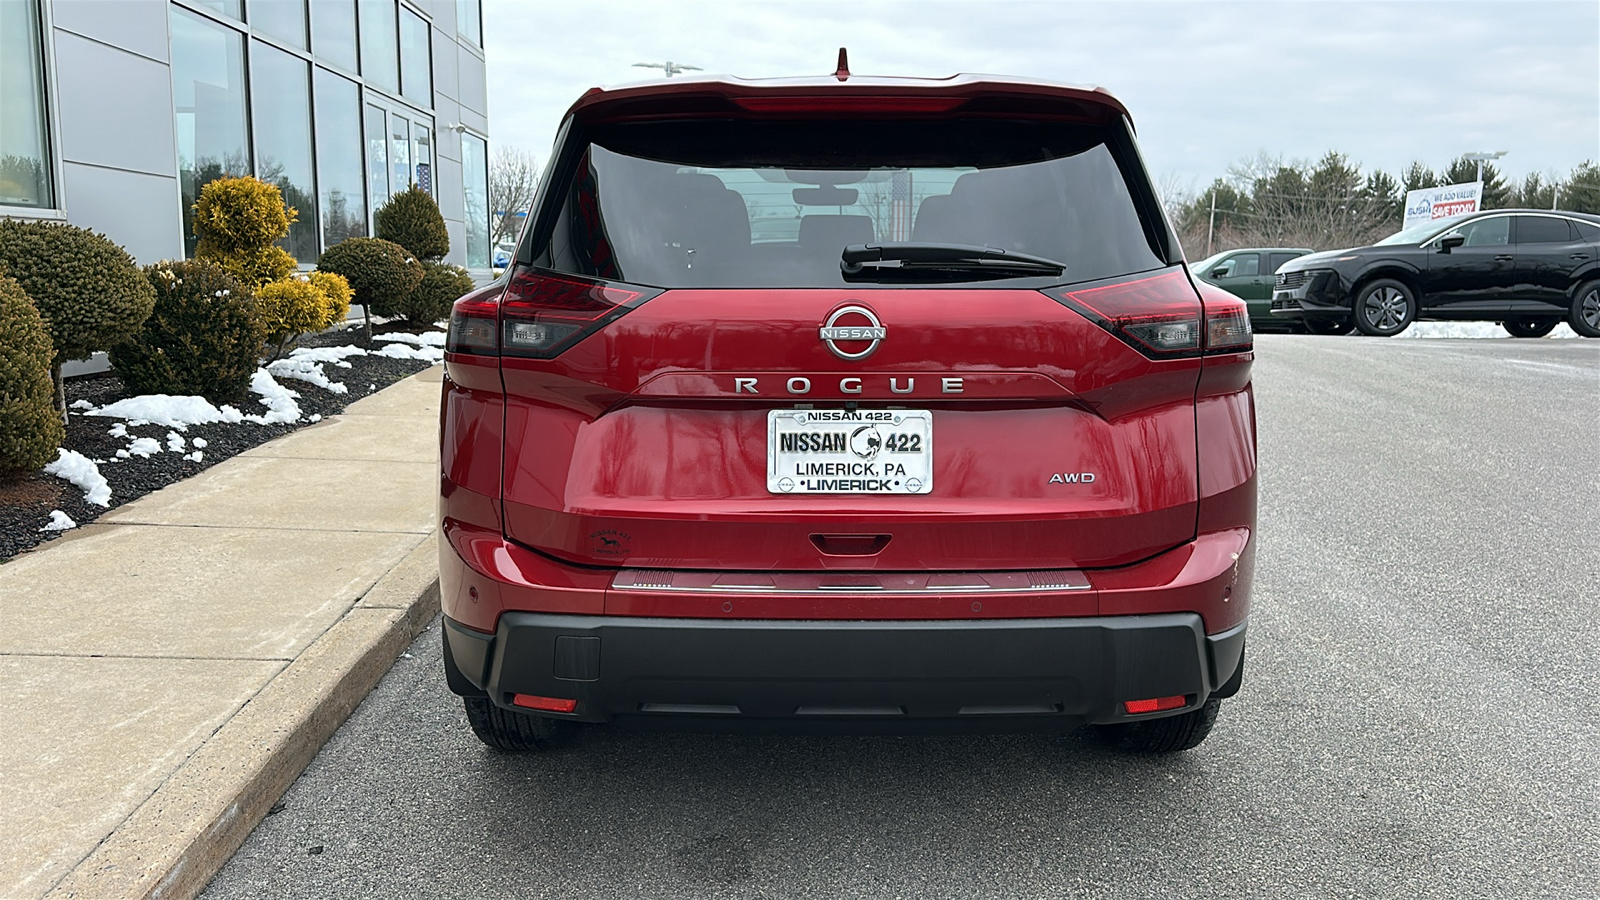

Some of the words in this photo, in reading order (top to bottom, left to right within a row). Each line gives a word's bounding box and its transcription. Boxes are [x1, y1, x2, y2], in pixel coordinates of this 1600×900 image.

[1434, 194, 1443, 202] WE
[1432, 206, 1450, 217] SAVE
[1451, 203, 1475, 214] TODAY
[821, 329, 885, 338] NISSAN
[734, 377, 964, 394] ROGUE
[807, 412, 862, 421] NISSAN
[865, 412, 892, 421] 422
[780, 432, 847, 453] NISSAN
[885, 433, 922, 453] 422
[796, 463, 879, 477] LIMERICK,
[884, 463, 906, 476] PA
[1048, 472, 1096, 484] AWD
[806, 479, 892, 491] LIMERICK
[590, 529, 617, 539] NISSAN
[619, 532, 632, 540] 422
